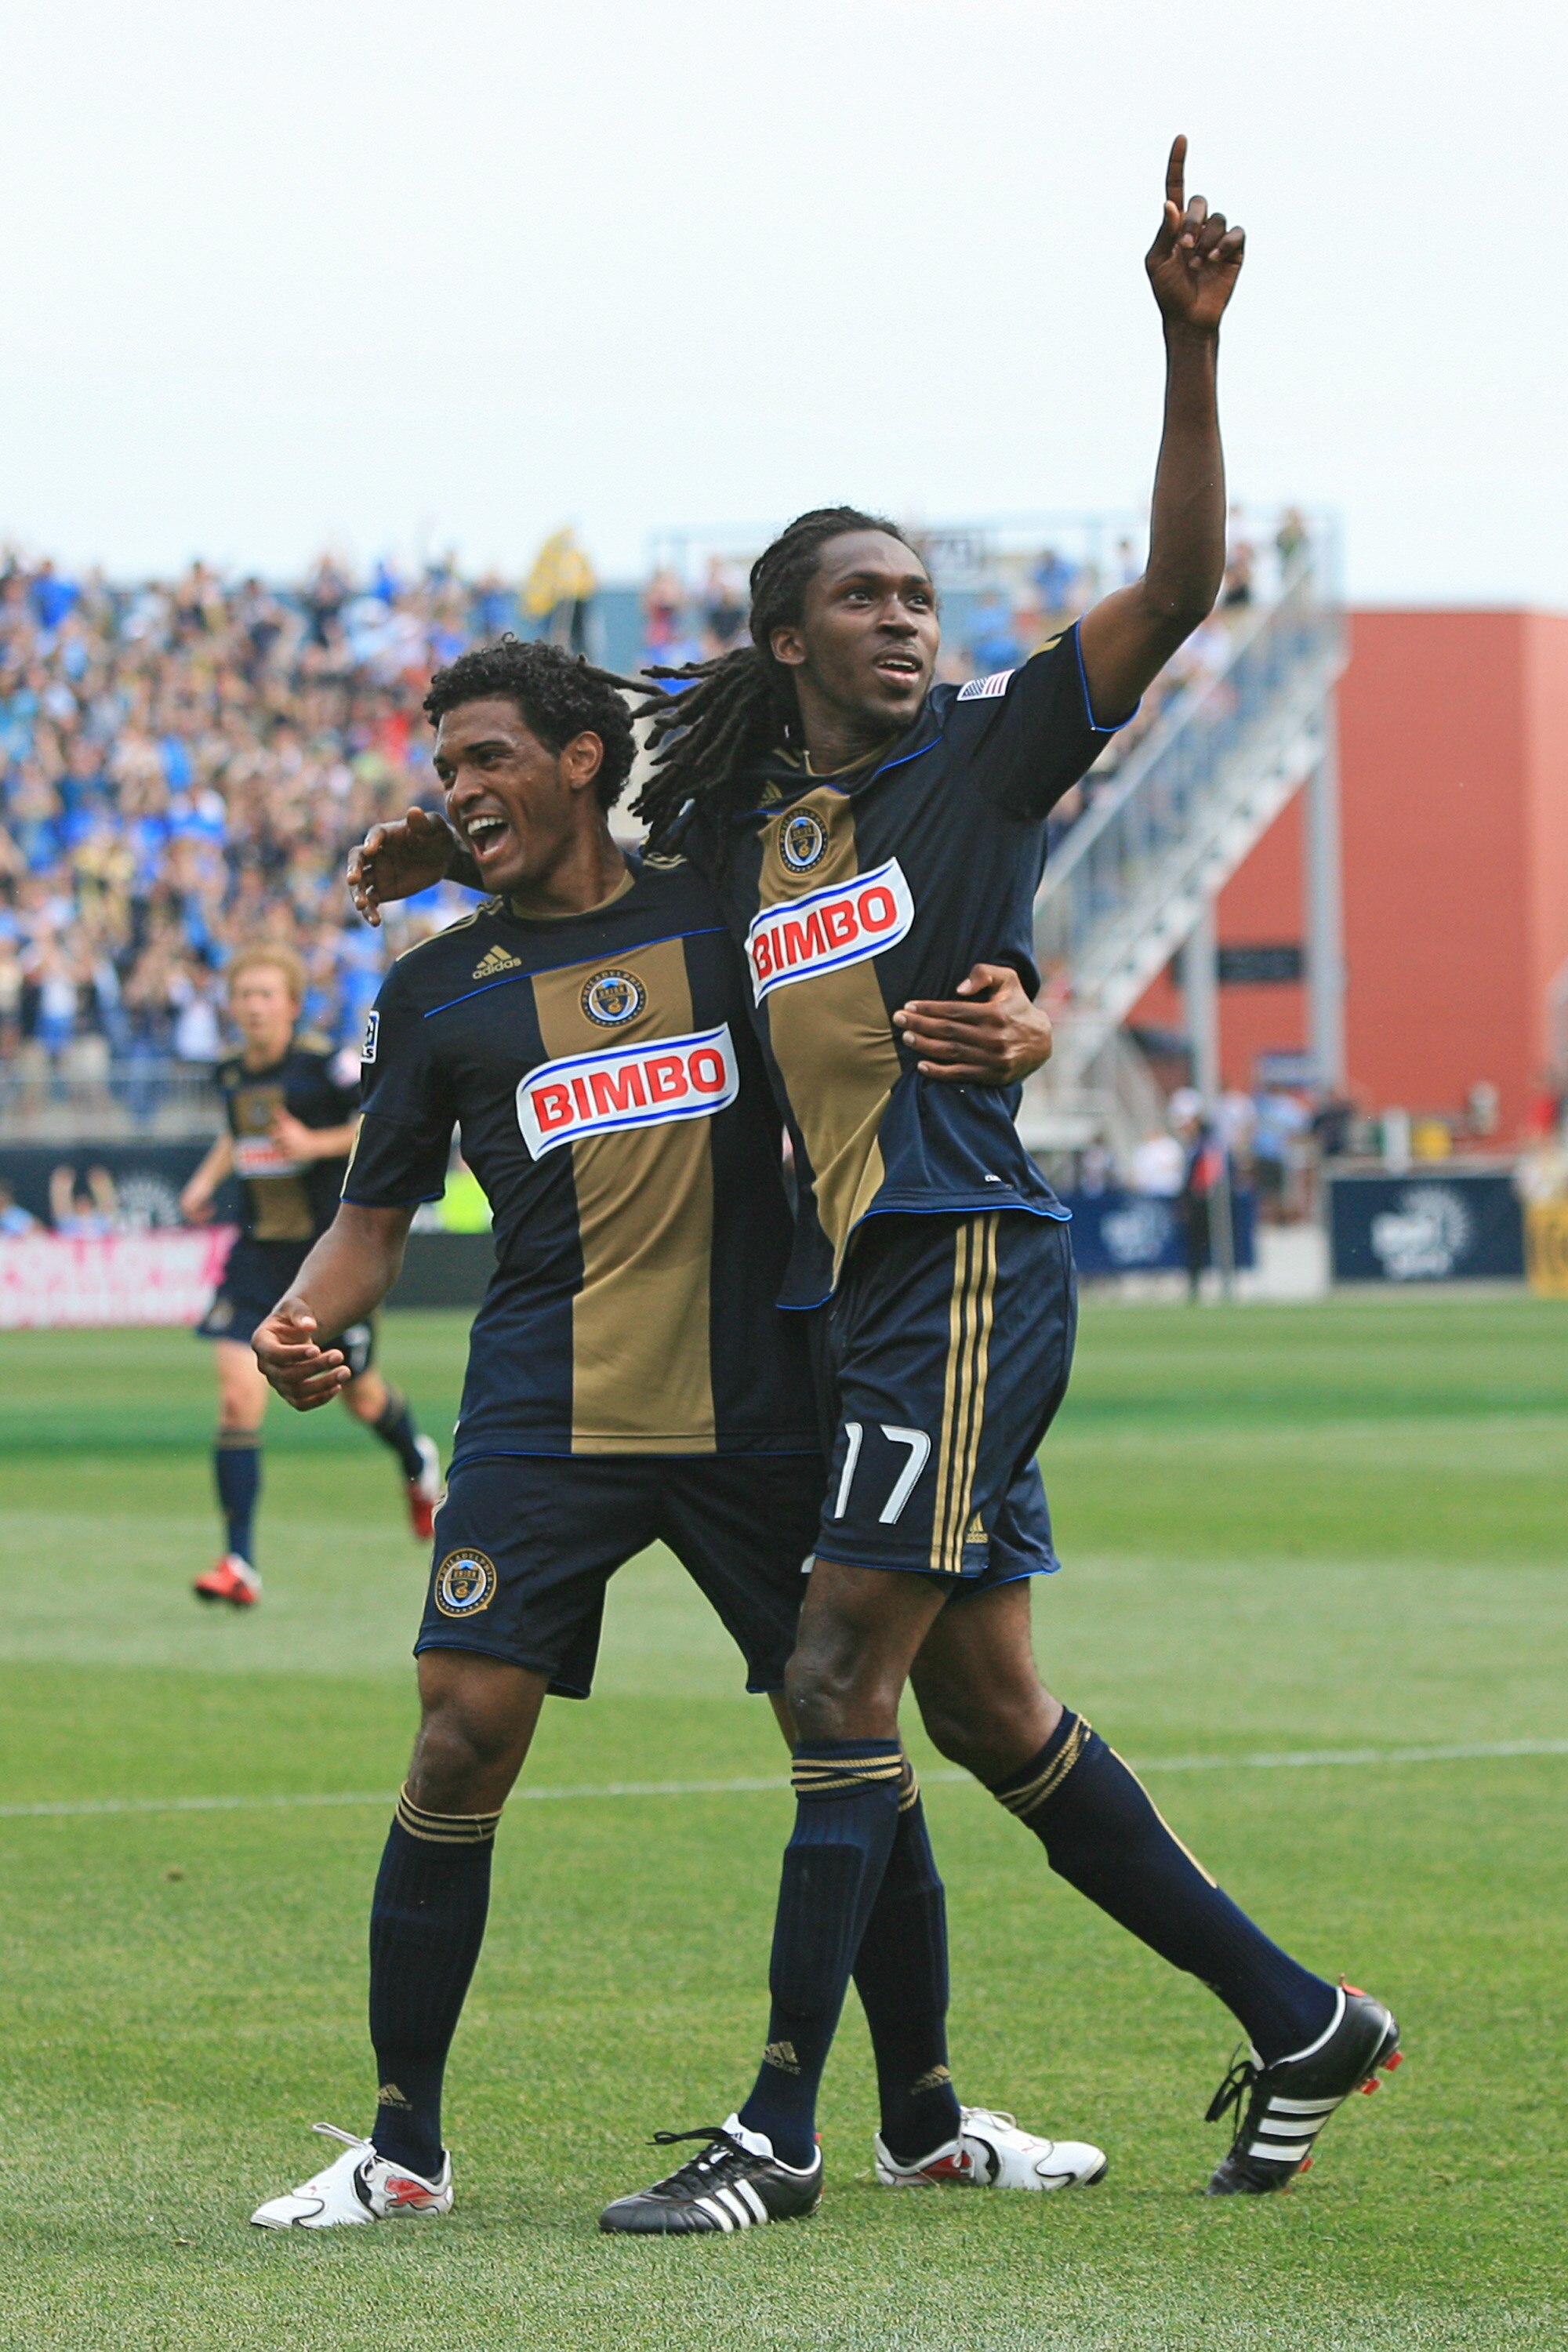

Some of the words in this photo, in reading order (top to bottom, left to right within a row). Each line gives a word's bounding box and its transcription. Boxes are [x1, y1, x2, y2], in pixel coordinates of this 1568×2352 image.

[473, 957, 522, 979] adidas
[753, 887, 898, 980] BIMBO
[531, 1049, 726, 1133] BIMBO
[834, 1422, 931, 1524] 17
